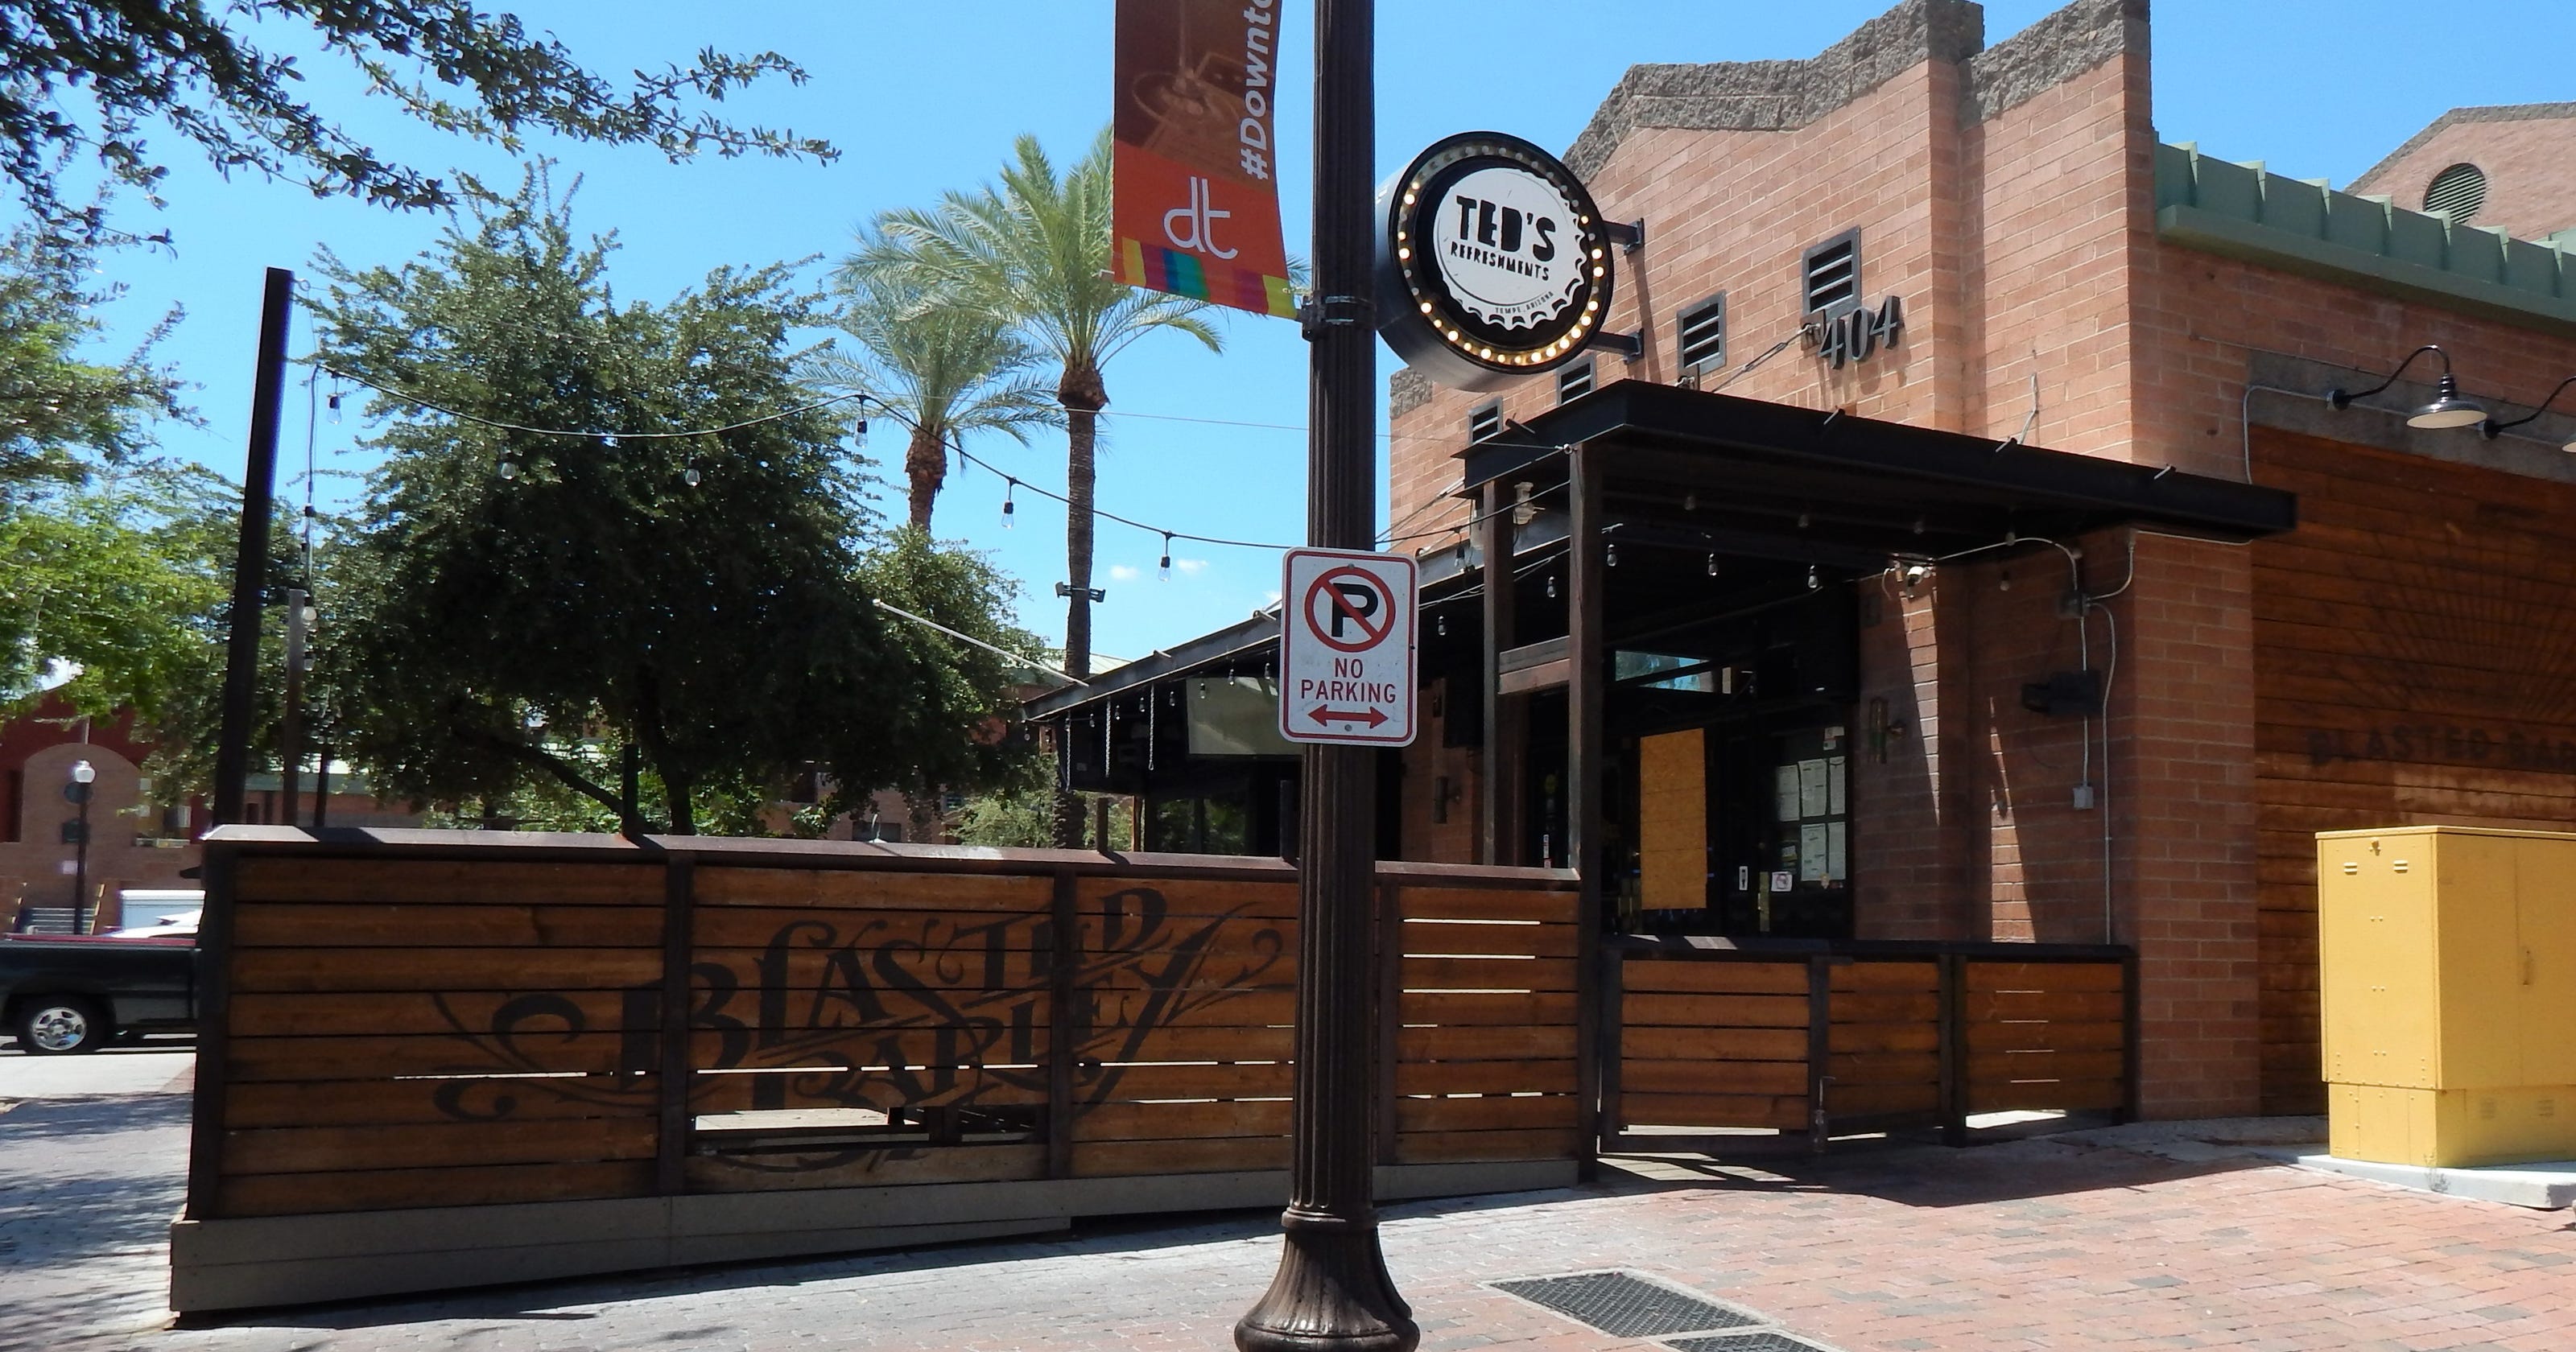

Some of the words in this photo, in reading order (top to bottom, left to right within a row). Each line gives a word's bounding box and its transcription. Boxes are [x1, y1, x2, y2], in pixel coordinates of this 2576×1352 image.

[1456, 196, 1556, 262] TED'S
[1451, 241, 1550, 281] REFRESHMENTS
[1818, 295, 1905, 369] 404
[1335, 657, 1363, 678] NO
[1301, 679, 1396, 703] PARKING
[2307, 723, 2490, 766] BLASTED
